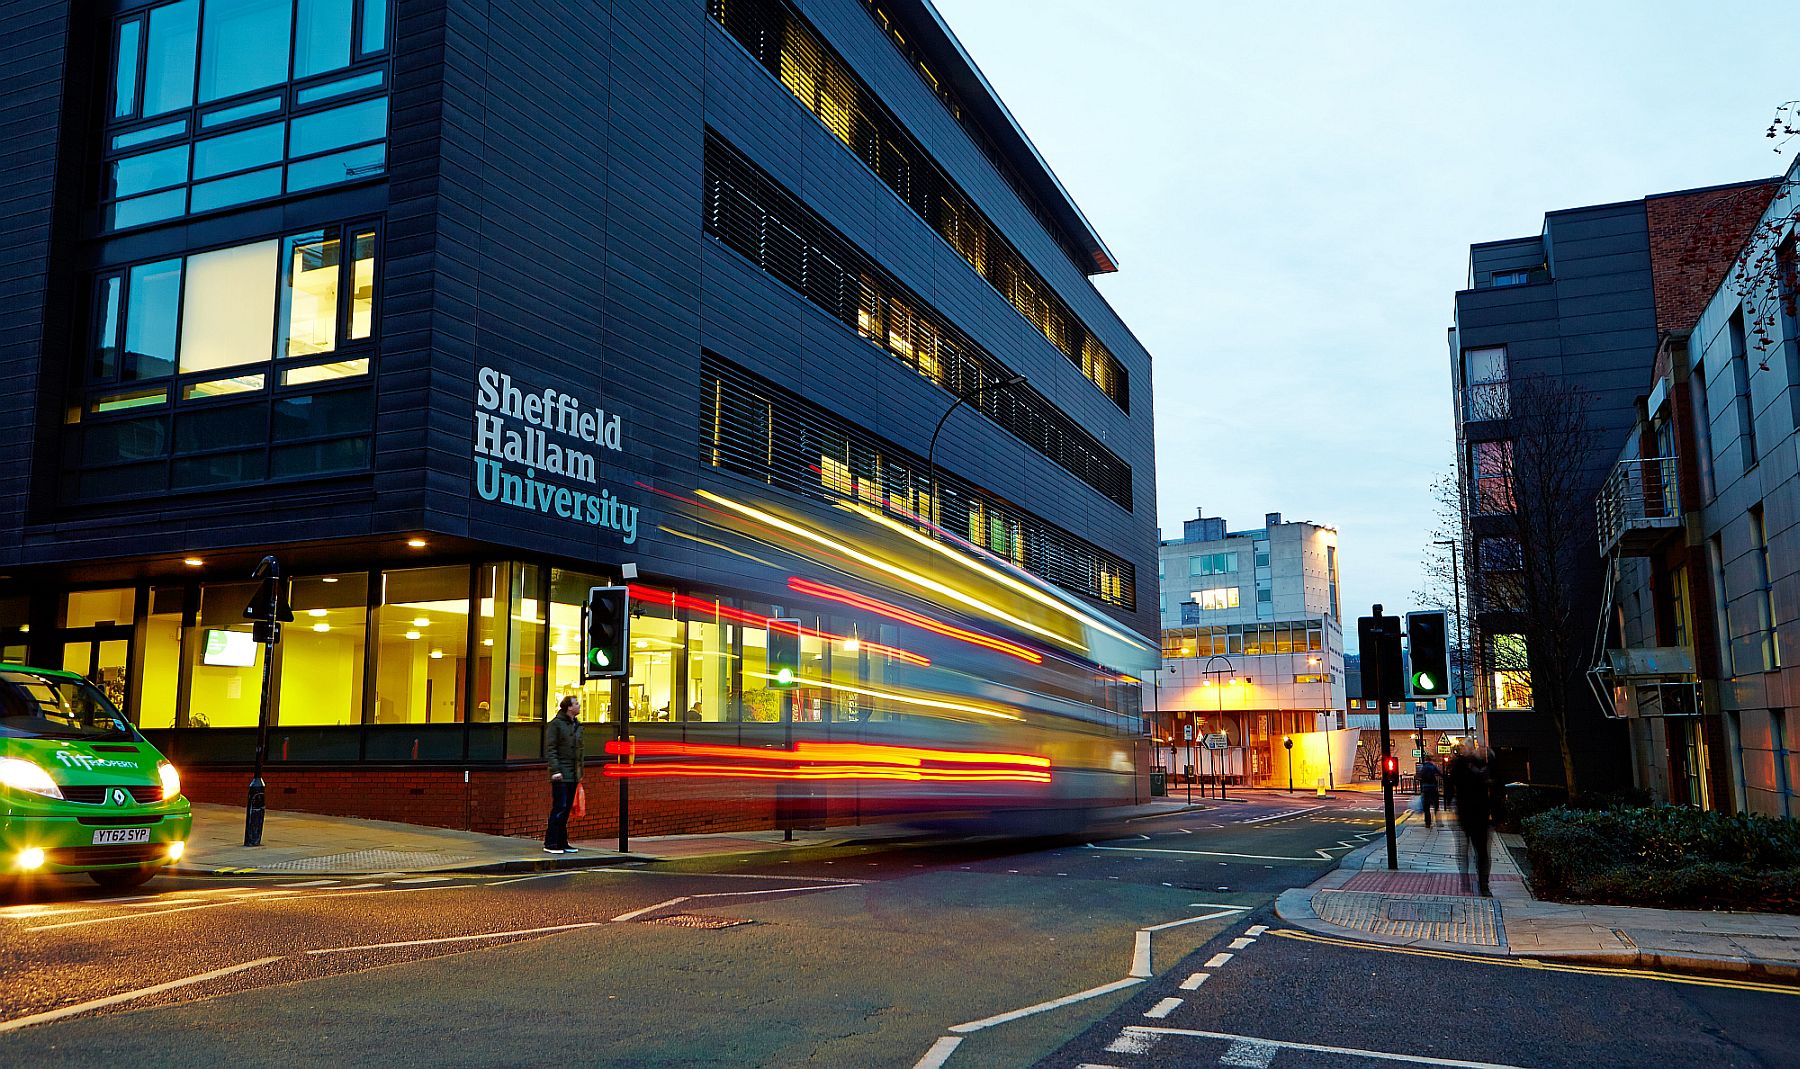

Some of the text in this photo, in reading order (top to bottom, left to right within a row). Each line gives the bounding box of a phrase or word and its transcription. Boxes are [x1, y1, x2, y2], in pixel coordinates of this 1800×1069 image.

[475, 410, 596, 483] Hallam
[478, 367, 622, 451] Sheffield
[474, 456, 639, 544] University
[99, 829, 146, 842] YT62 SYP
